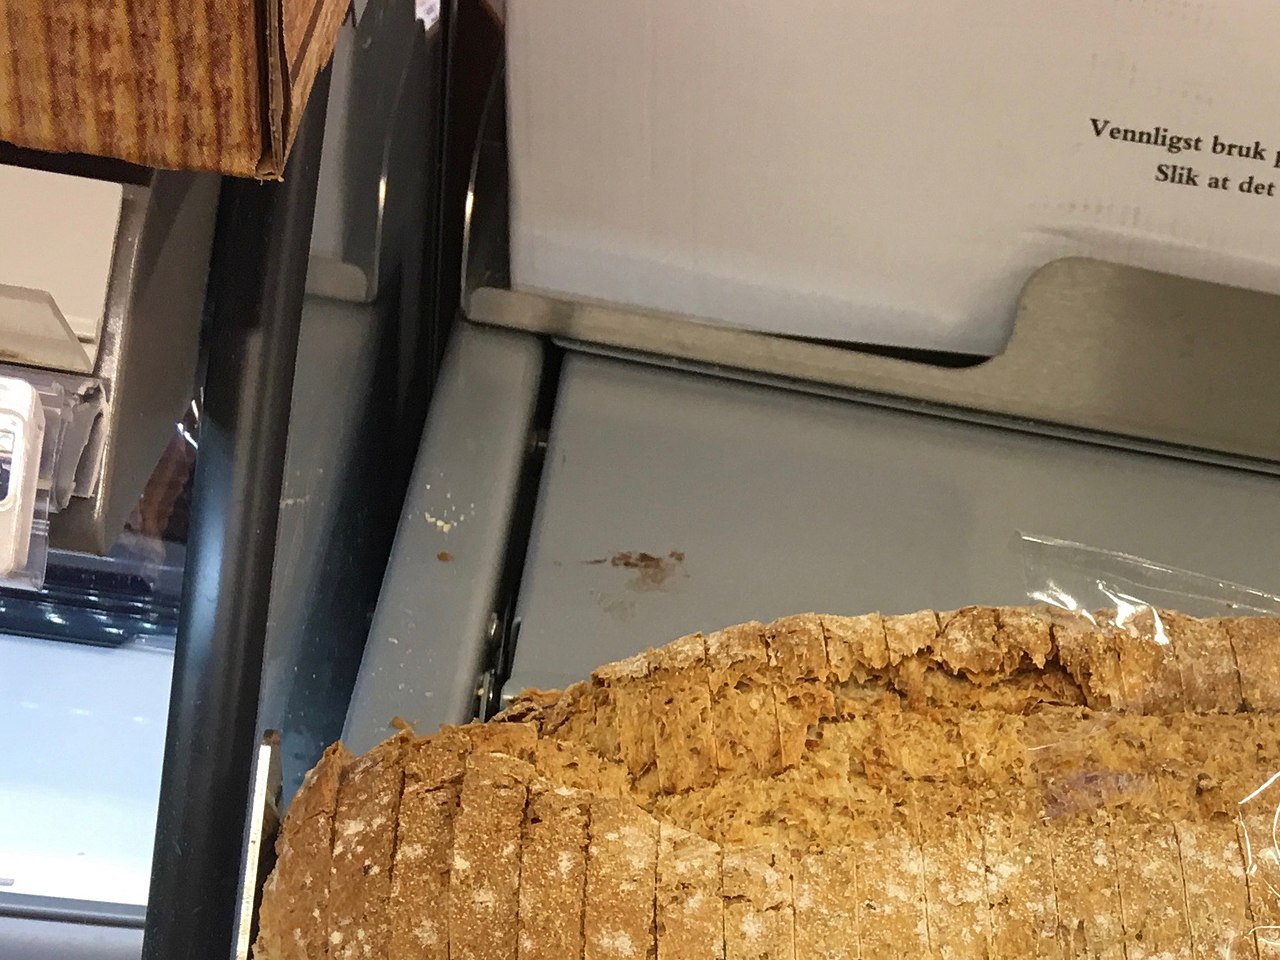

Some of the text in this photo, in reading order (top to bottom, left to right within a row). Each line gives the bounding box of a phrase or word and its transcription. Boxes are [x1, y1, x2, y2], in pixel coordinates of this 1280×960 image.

[1090, 118, 1203, 153] Vennligst
[1211, 135, 1266, 161] bruk
[1155, 163, 1199, 187] Slik
[1207, 176, 1231, 190] at
[1238, 176, 1276, 197] det
